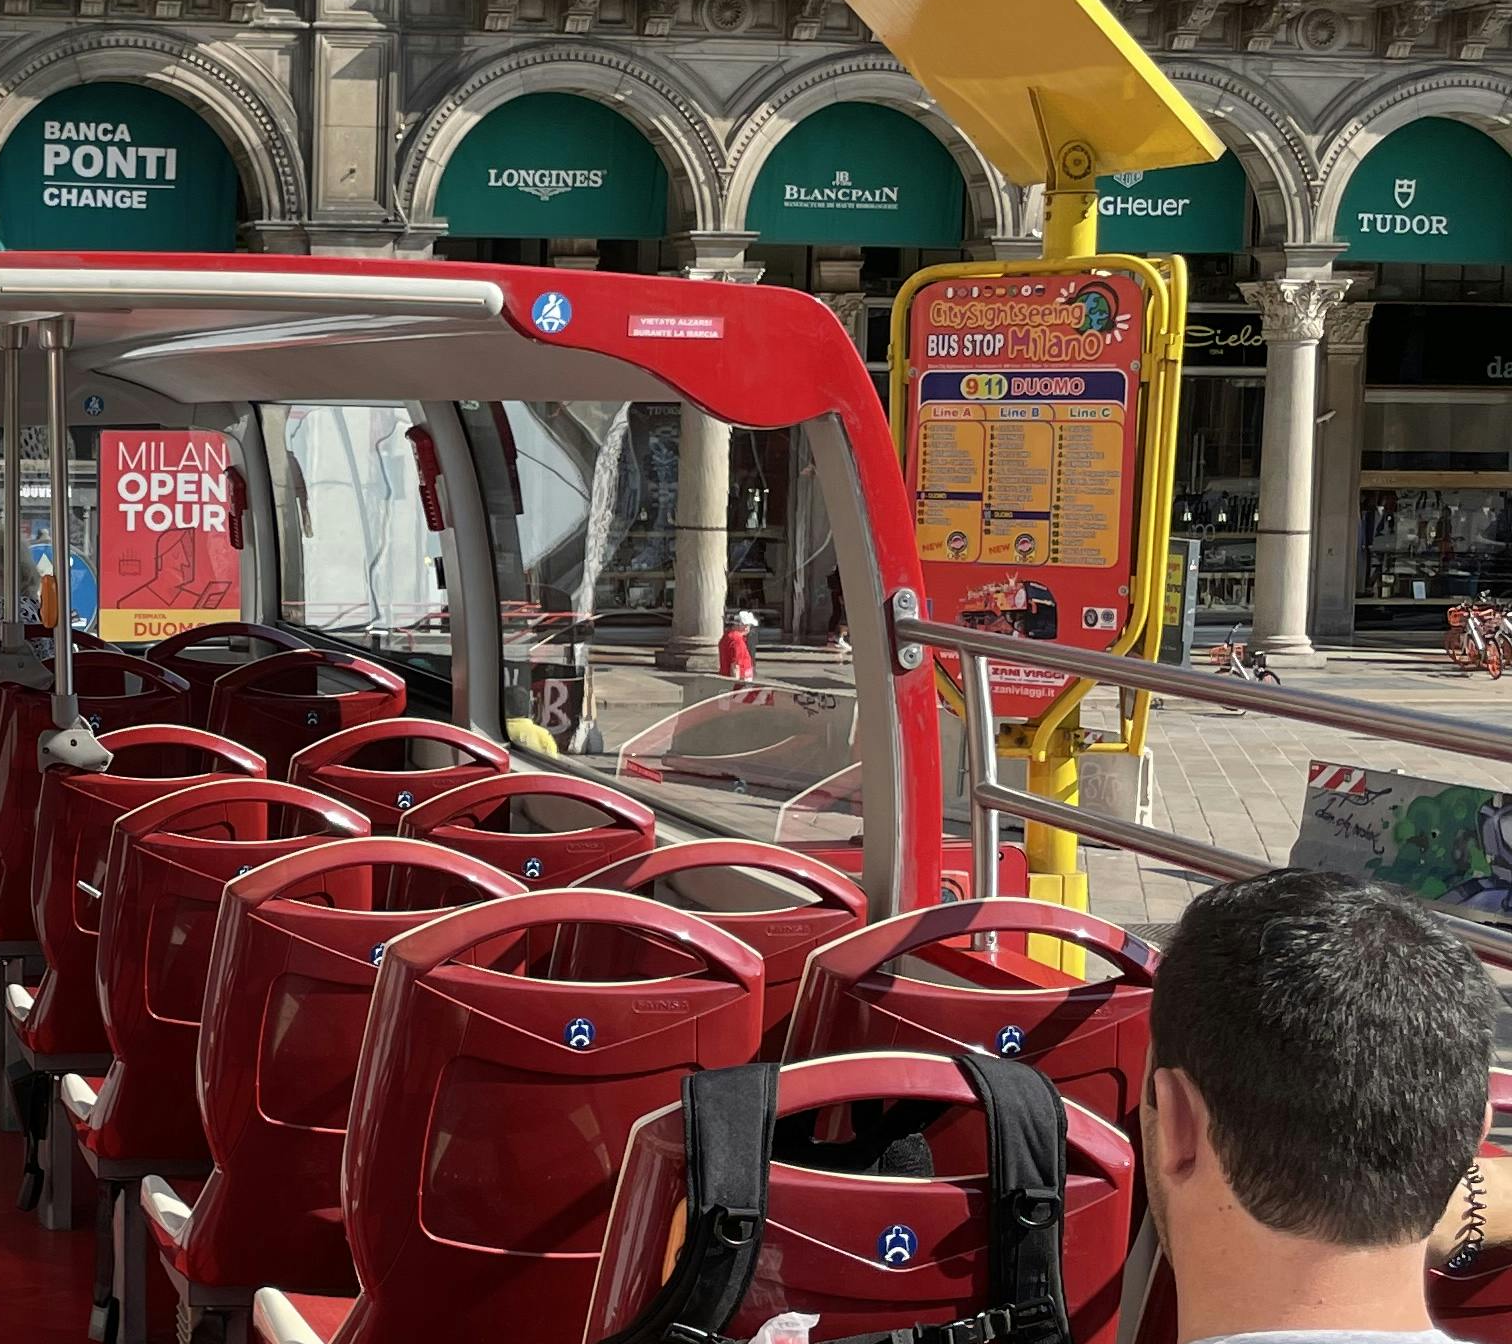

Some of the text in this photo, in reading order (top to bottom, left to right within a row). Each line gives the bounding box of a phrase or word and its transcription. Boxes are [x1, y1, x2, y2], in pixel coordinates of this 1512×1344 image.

[44, 121, 131, 142] BANCA
[43, 143, 177, 180] PONTI
[488, 169, 604, 187] LONGINES
[43, 187, 147, 209] CHANGE
[1098, 196, 1191, 216] GHeuer
[1358, 213, 1448, 235] TUDOR
[640, 317, 676, 326] VIETATO
[930, 300, 1086, 329] CitySightseeing
[928, 326, 1104, 362] BUS STOP Milano
[965, 376, 1086, 396] 9 11 DUOMO
[933, 407, 972, 418] Line A
[1000, 407, 1040, 418] Line B
[1069, 407, 1112, 418] Line C
[118, 441, 227, 472] MILAN
[117, 472, 228, 503] OPEN
[118, 503, 226, 533] TOUR
[134, 622, 208, 637] DUOM
[991, 666, 1021, 677] ZANI
[1023, 669, 1066, 680] VIAGGI
